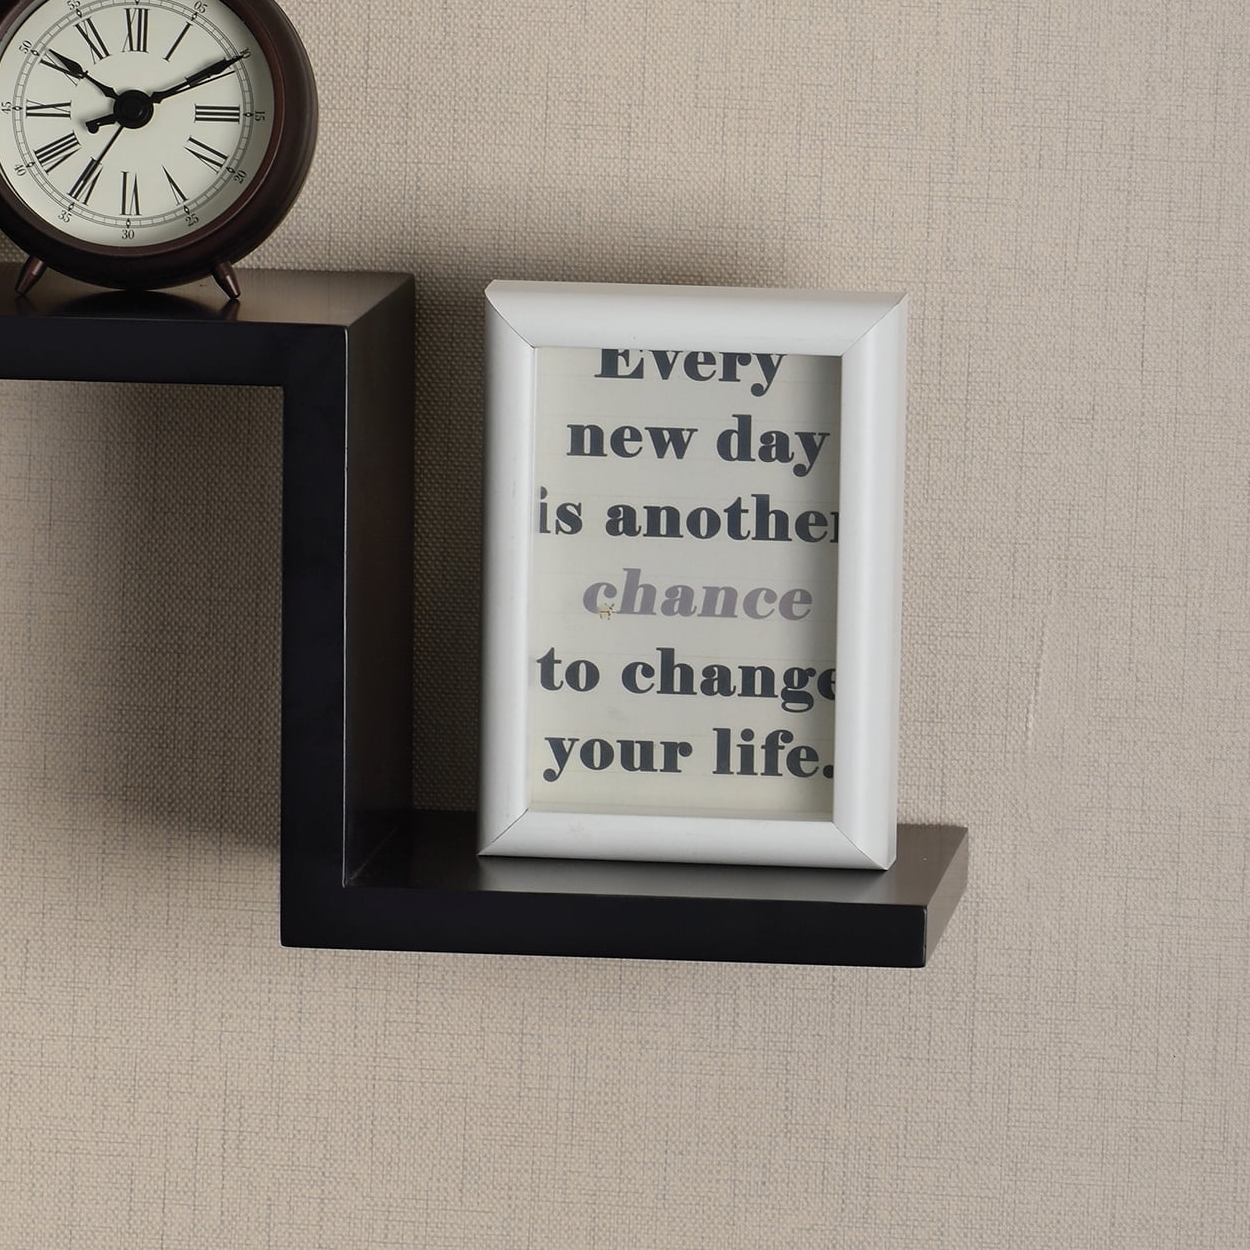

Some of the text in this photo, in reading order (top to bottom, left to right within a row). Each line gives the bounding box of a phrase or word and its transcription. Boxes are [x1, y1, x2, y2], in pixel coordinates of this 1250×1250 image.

[193, 0, 208, 13] 05
[19, 40, 32, 54] 50
[254, 111, 265, 122] 15
[14, 163, 27, 176] 40
[234, 170, 247, 184] 20
[58, 210, 72, 223] 35
[185, 213, 199, 227] 25
[121, 229, 135, 239] 30
[594, 349, 787, 397] Every
[566, 414, 830, 477] new day
[539, 486, 583, 535] is
[583, 568, 813, 621] chance
[536, 647, 600, 691] to
[543, 728, 834, 782] your life.
